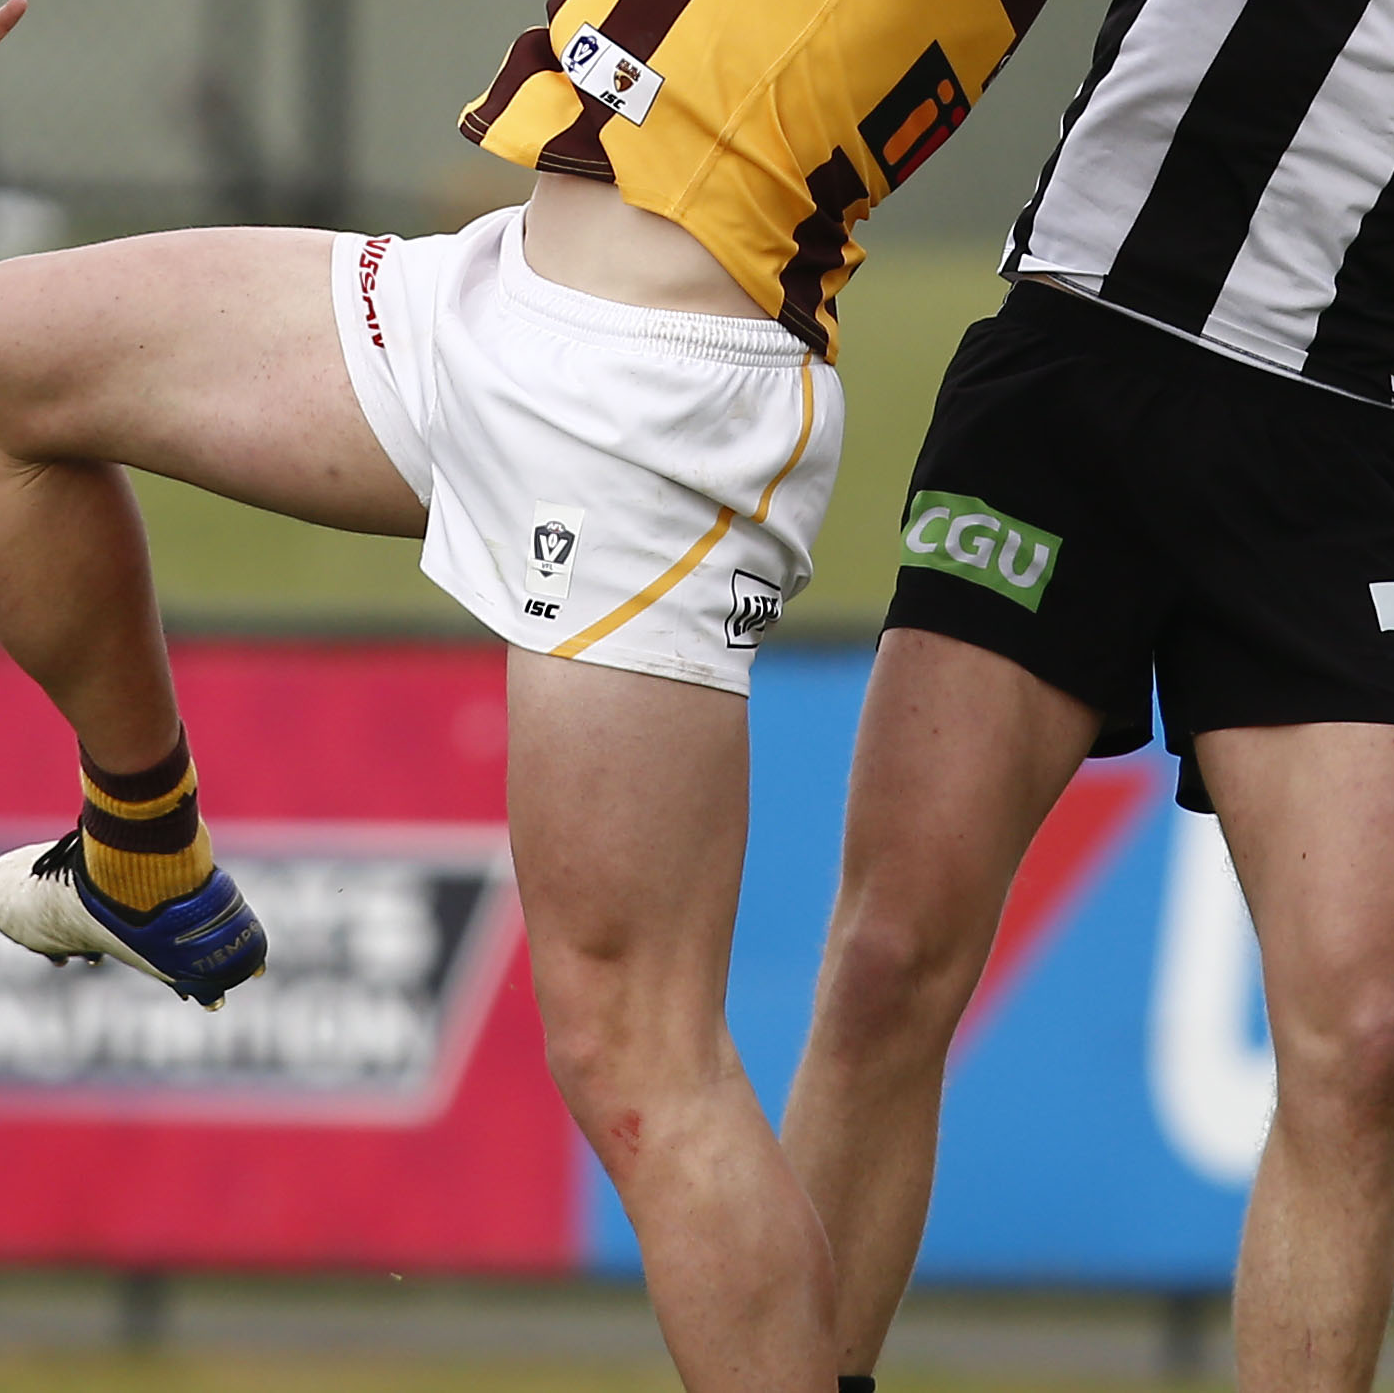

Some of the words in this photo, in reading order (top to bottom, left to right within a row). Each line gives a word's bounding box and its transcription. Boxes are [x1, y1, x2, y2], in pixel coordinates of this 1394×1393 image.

[599, 90, 626, 110] ISC
[906, 506, 1049, 589] CGU
[524, 598, 560, 620] ISC
